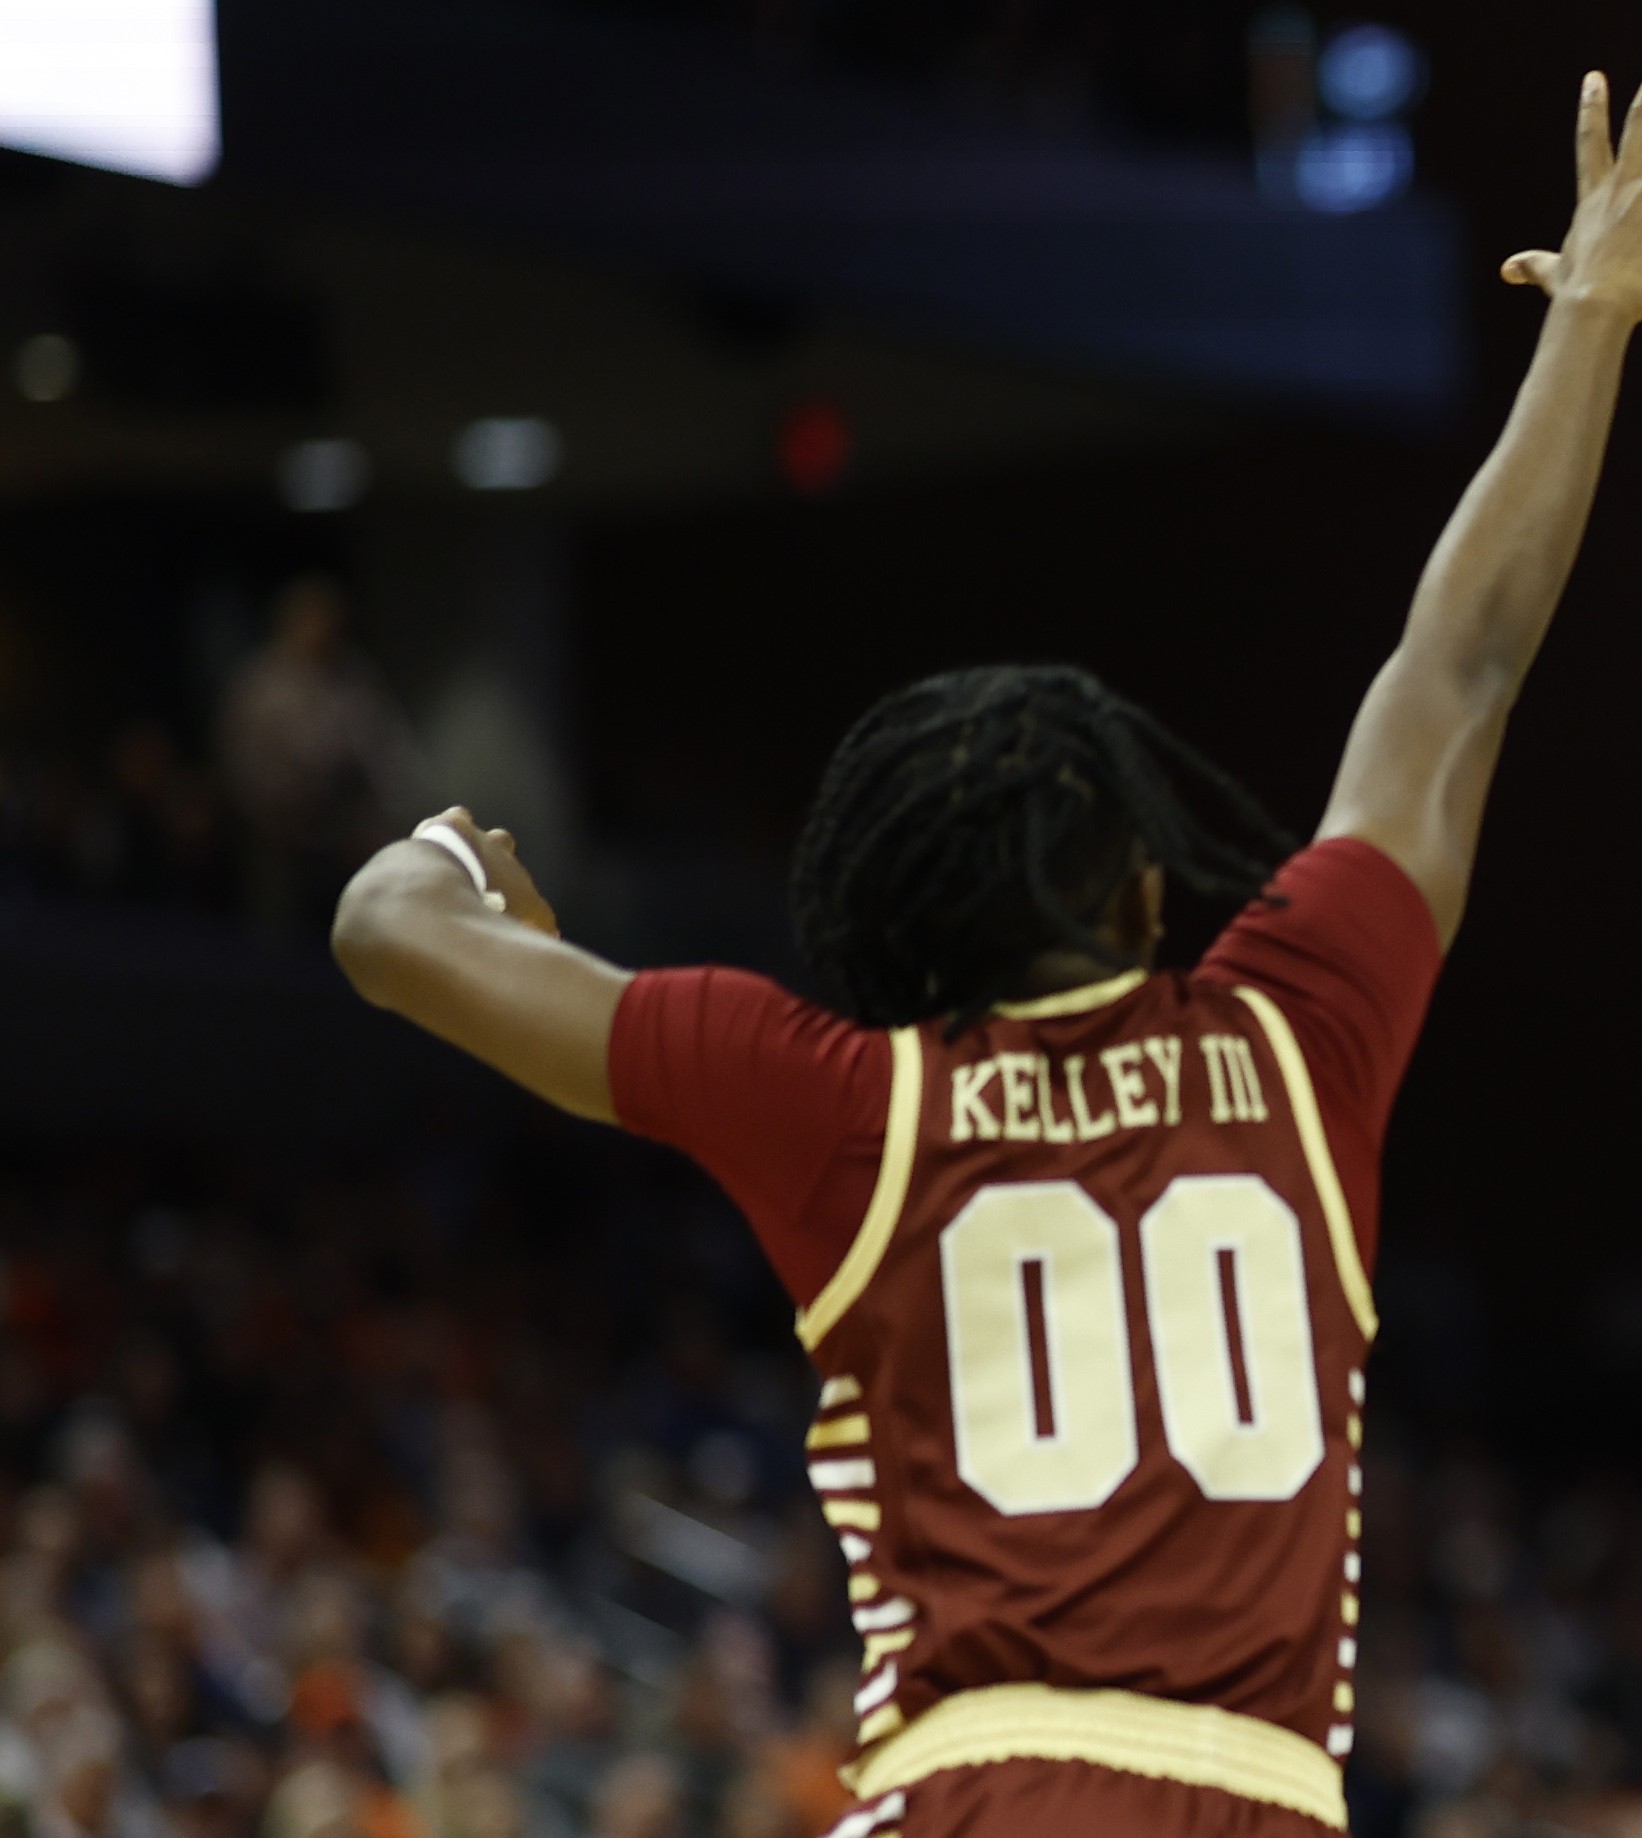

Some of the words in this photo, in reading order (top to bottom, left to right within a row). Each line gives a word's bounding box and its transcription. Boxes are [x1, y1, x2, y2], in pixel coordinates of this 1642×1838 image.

[951, 1034, 1182, 1143] KELLEY
[1198, 1033, 1268, 1124] III
[939, 1174, 1326, 1516] 00
